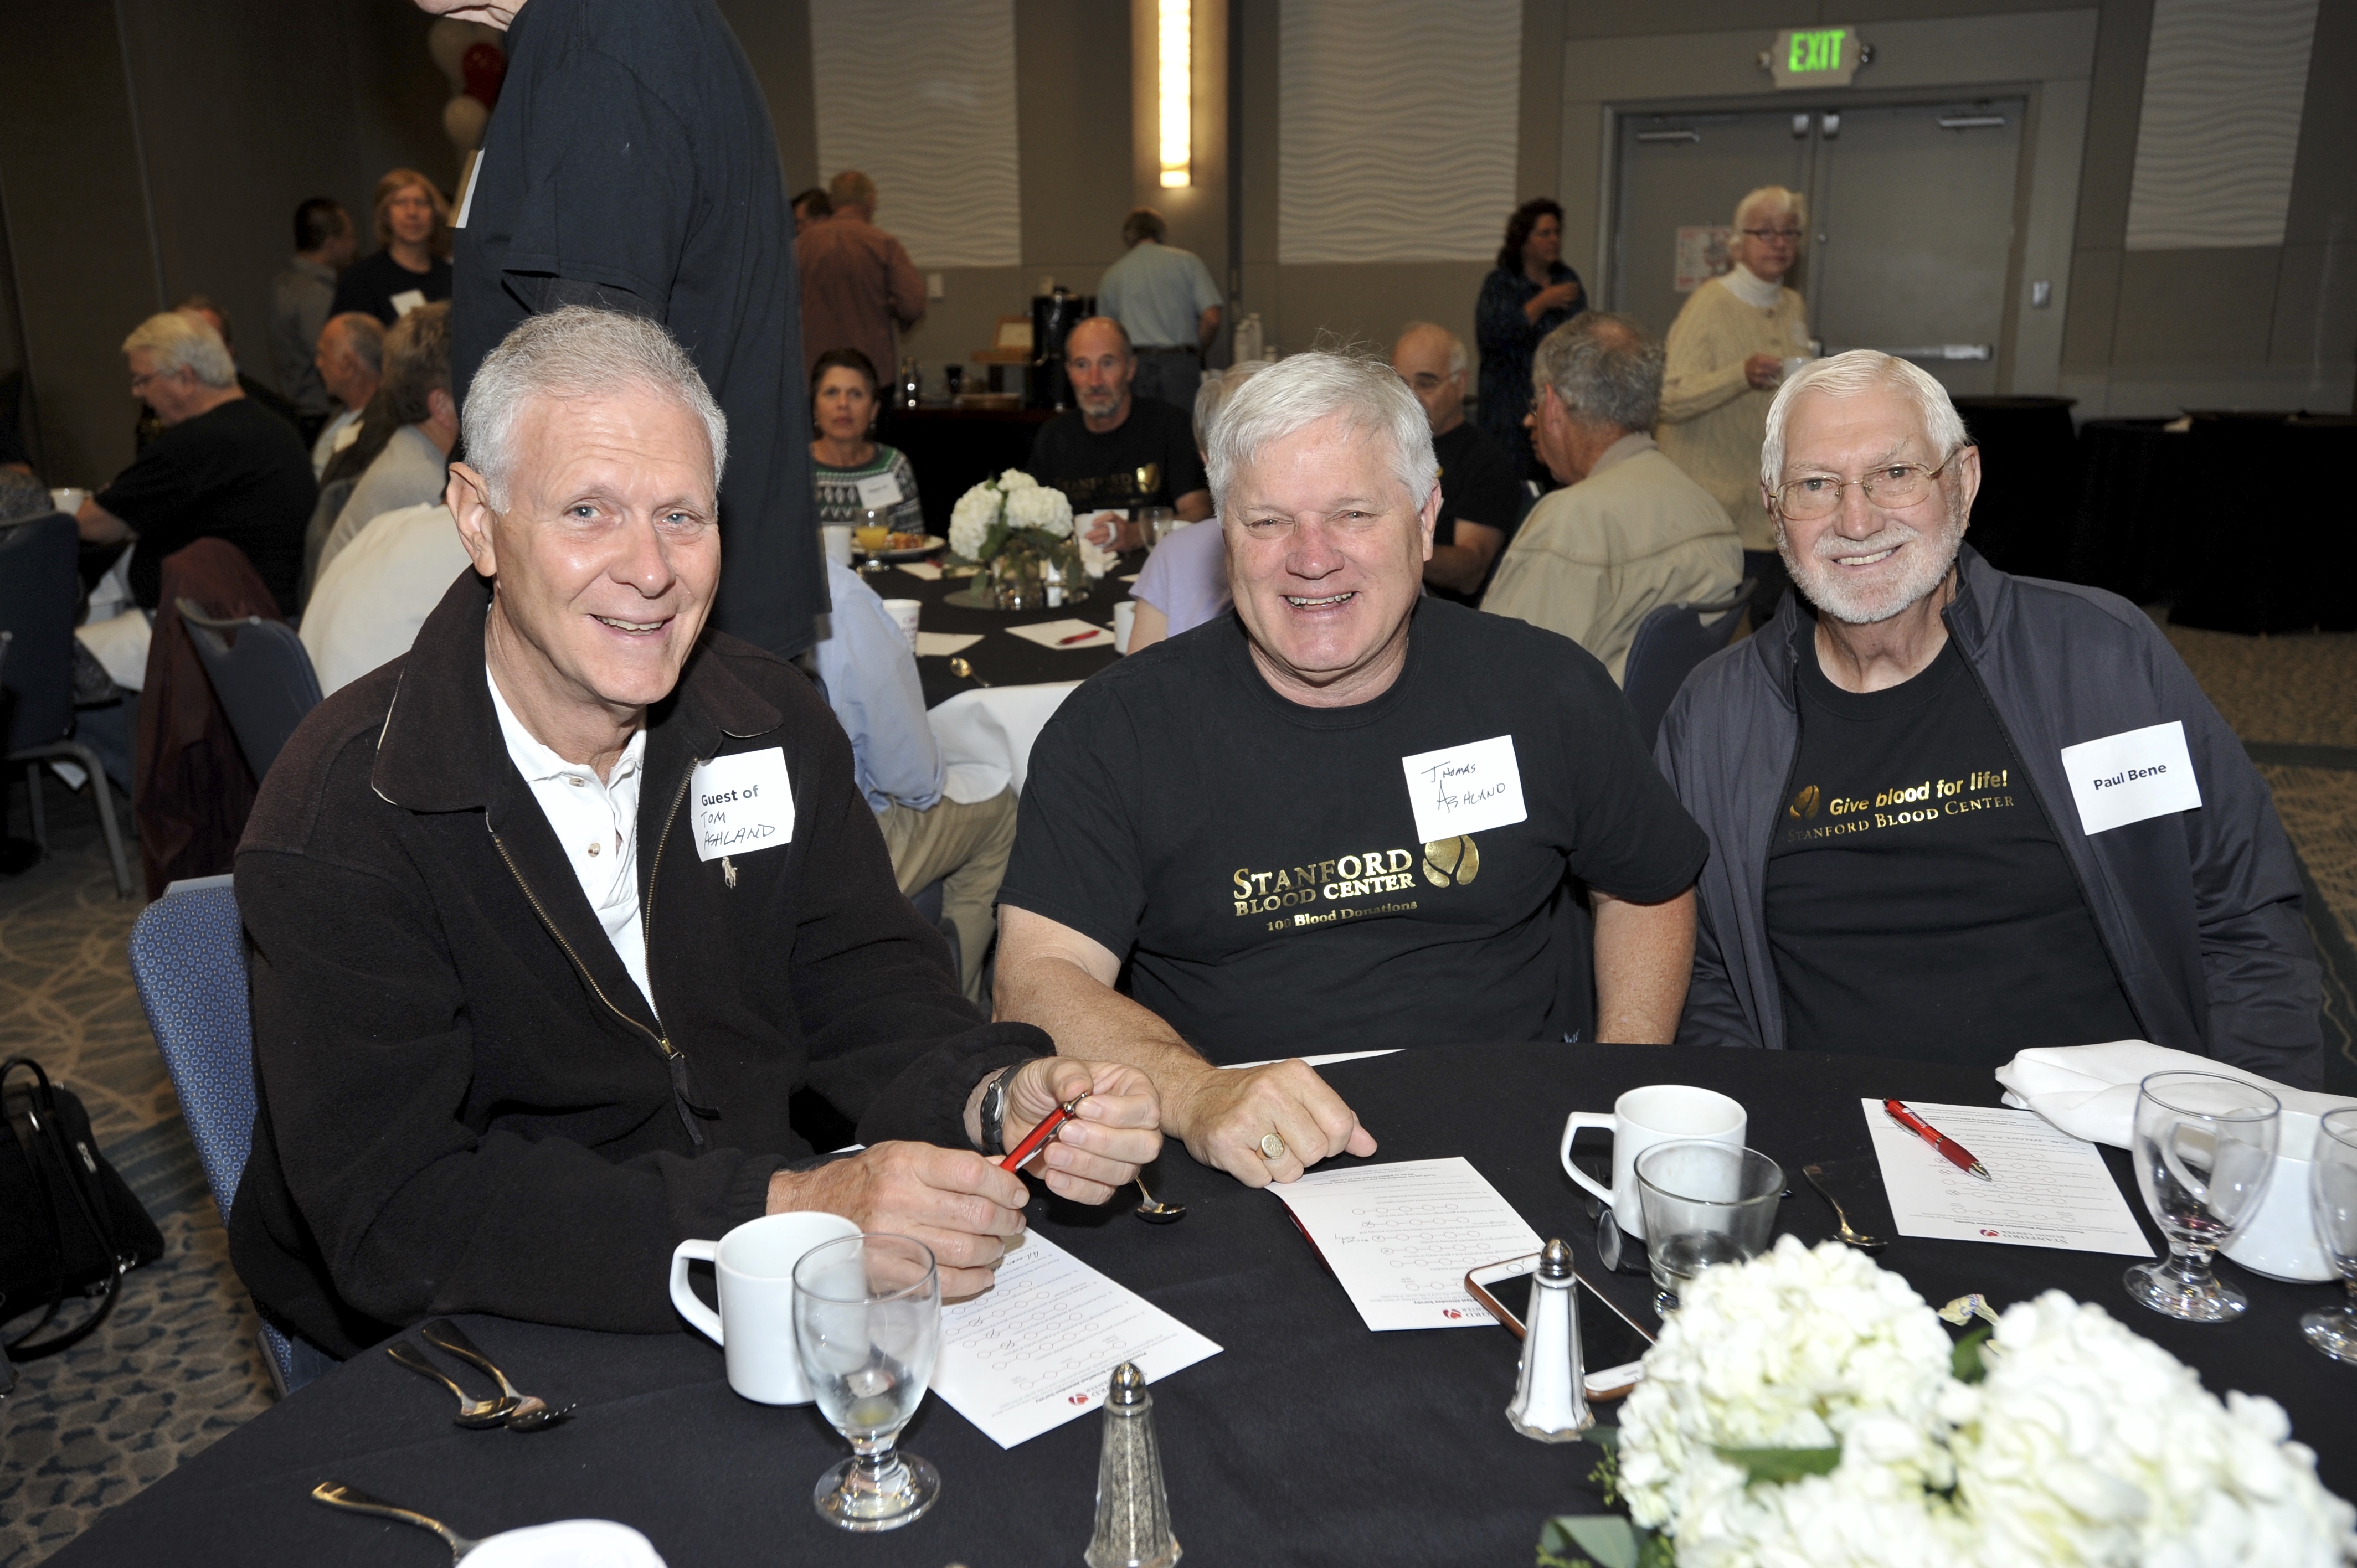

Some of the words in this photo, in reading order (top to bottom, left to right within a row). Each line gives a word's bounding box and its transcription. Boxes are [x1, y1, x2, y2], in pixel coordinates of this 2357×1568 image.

[1789, 29, 1846, 72] EXIT
[701, 790, 738, 806] Guest
[743, 785, 759, 798] of
[1830, 798, 1869, 816] Give
[1876, 781, 1929, 808] blood
[1937, 779, 1963, 798] for
[1970, 770, 2007, 791] life!
[2093, 772, 2125, 790] Paul
[2128, 765, 2167, 781] Bene
[701, 811, 726, 828] TOM
[704, 824, 775, 850] ASHLAND
[1788, 820, 1869, 842] STANFORD
[1875, 808, 1938, 828] BLOOD
[1945, 796, 2014, 814] CENTER
[1233, 849, 1412, 900] STANFORD
[1234, 888, 1316, 916] BLOOD
[1324, 873, 1416, 900] CENTER
[1267, 918, 1291, 931] 100
[1294, 910, 1337, 927] Blood
[1340, 901, 1417, 920] Donations
